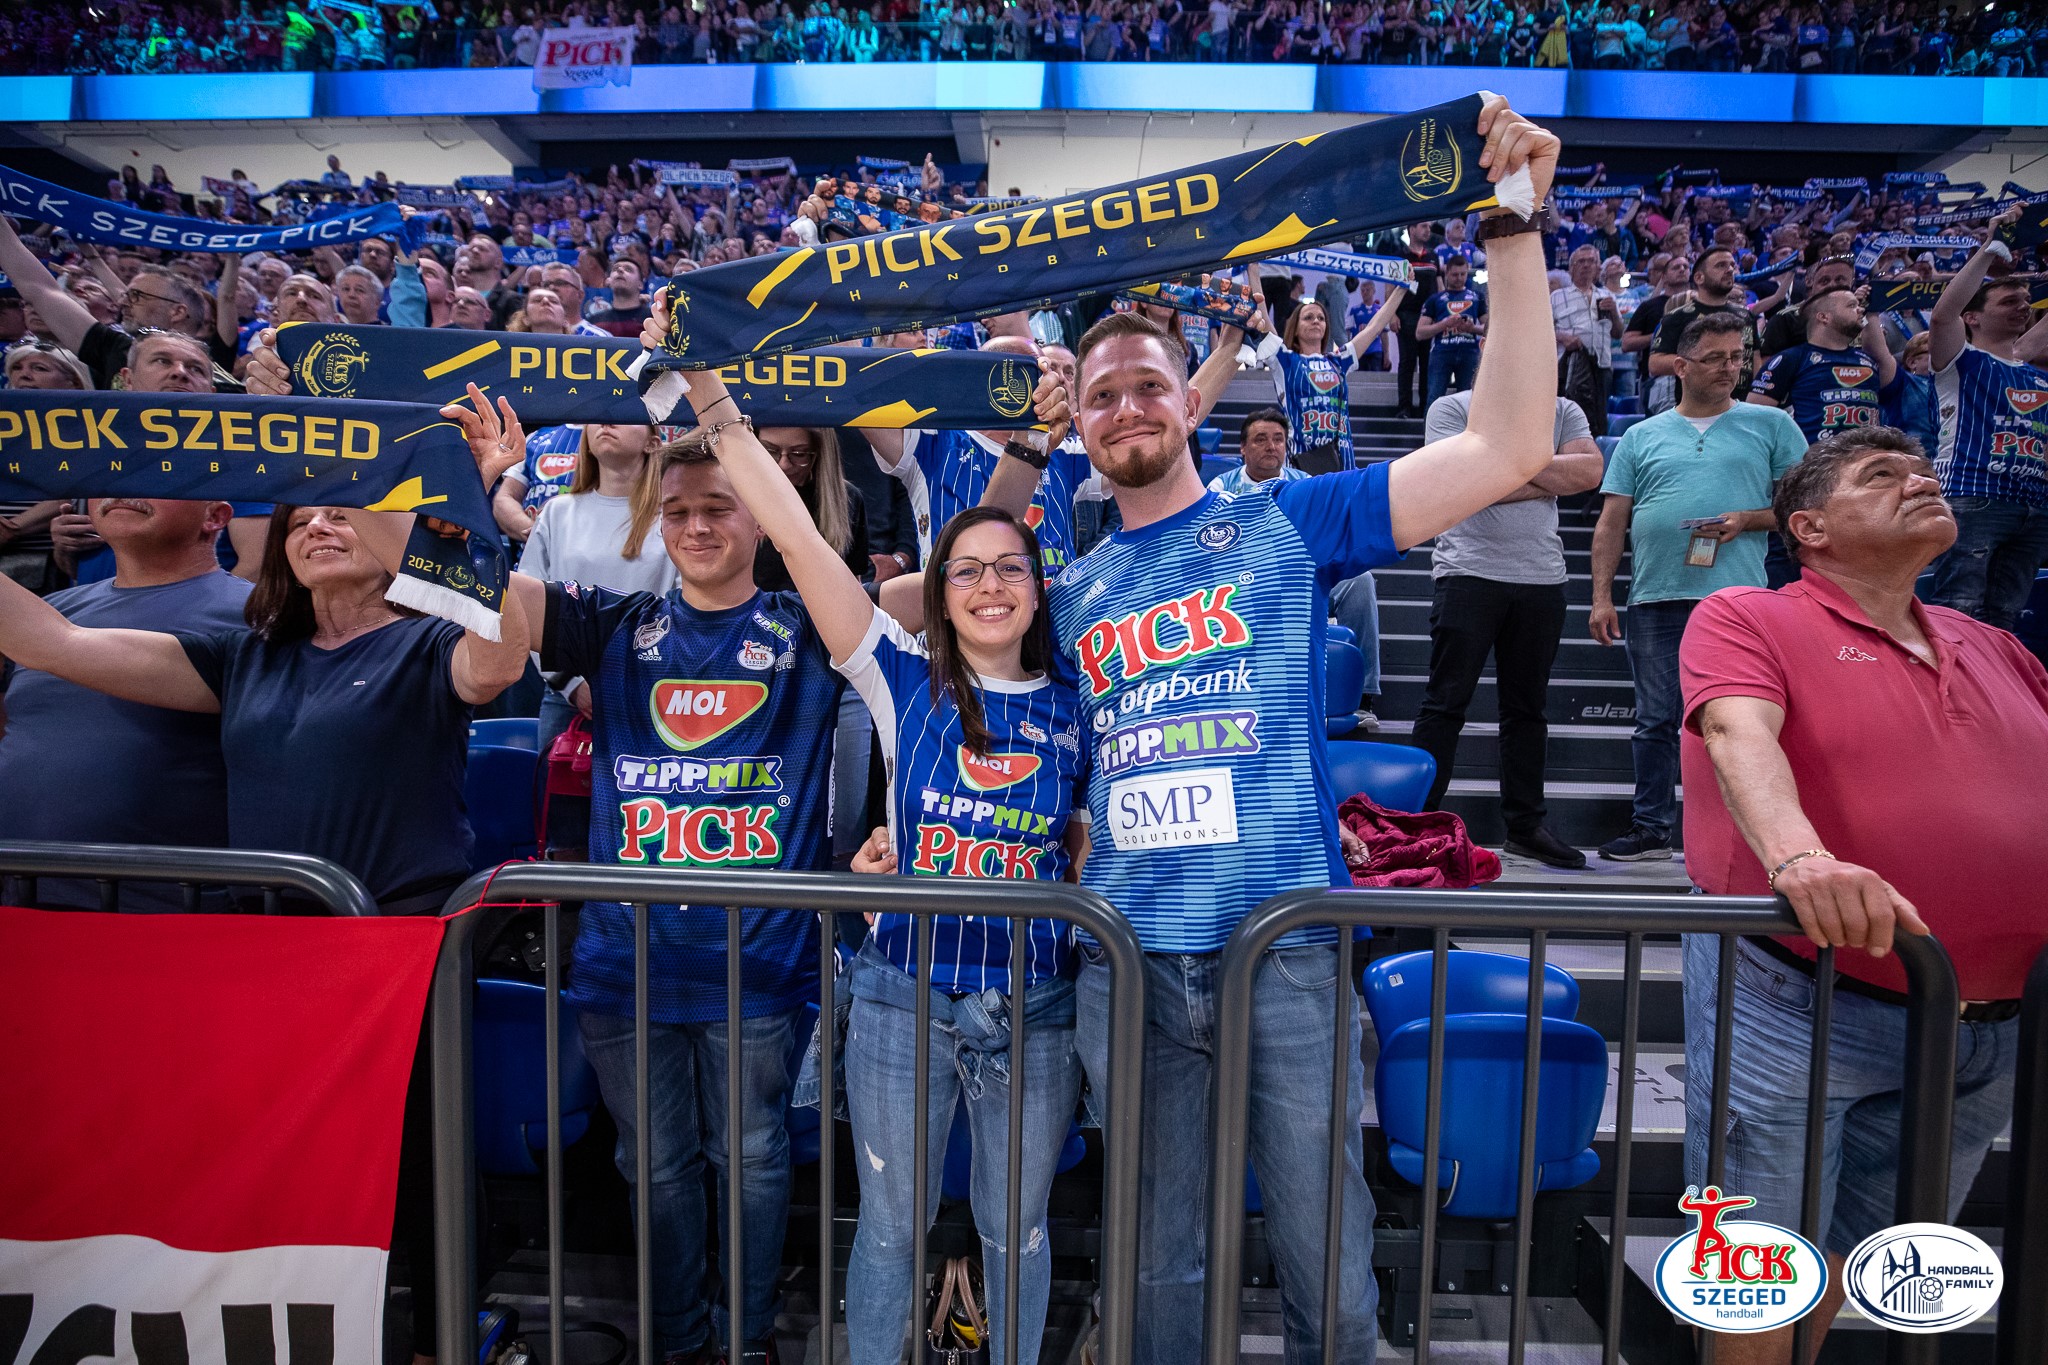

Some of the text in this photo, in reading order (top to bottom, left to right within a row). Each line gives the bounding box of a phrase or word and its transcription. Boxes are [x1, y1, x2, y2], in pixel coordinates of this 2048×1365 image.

[1420, 119, 1428, 162] HANDBALL
[1428, 118, 1436, 149] FAMILY
[91, 211, 270, 249] SZEGED
[279, 216, 374, 246] PICK
[825, 173, 1220, 286] PICK SZEGED
[325, 353, 335, 381] SZEGED
[510, 347, 635, 381] PICK
[1314, 374, 1335, 382] MOL
[1840, 367, 1862, 377] MOL
[2012, 391, 2039, 403] MOL
[140, 408, 380, 460] SZEGED
[1990, 432, 2044, 459] PIC
[542, 456, 575, 468] MOL
[408, 554, 442, 575] 2021
[1077, 585, 1252, 696] PICK
[637, 653, 663, 662] adidas
[665, 690, 728, 716] MOL
[968, 752, 1013, 775] MOL
[1121, 784, 1213, 831] SMP
[620, 797, 779, 863] PICK
[1124, 828, 1219, 845] SOLUTIONS
[913, 823, 1044, 880] PICK
